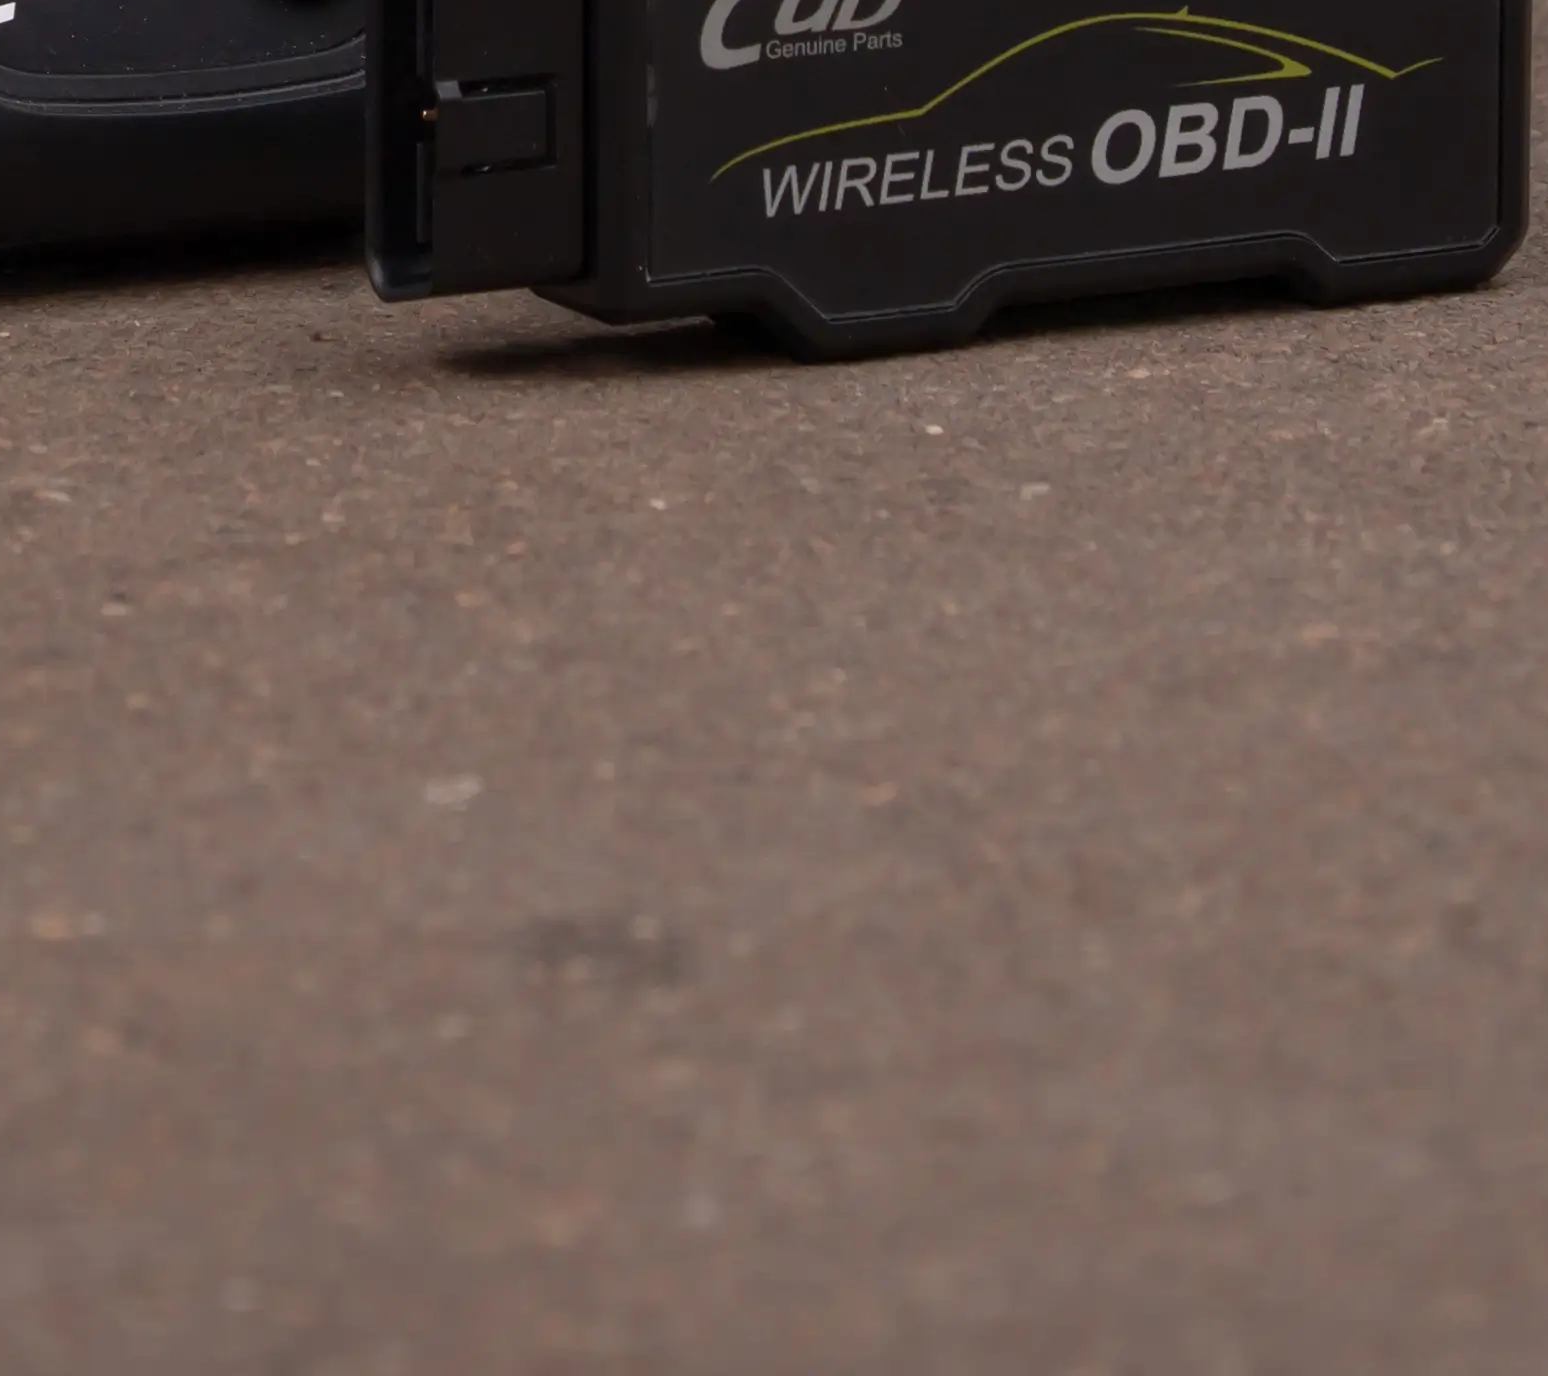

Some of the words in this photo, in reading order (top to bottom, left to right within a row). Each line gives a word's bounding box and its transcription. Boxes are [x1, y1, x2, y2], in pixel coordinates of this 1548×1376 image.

[765, 36, 847, 60] Genuine
[853, 32, 903, 52] Parts
[762, 133, 1076, 218] WIRELESS
[1090, 83, 1366, 185] OBD-II
